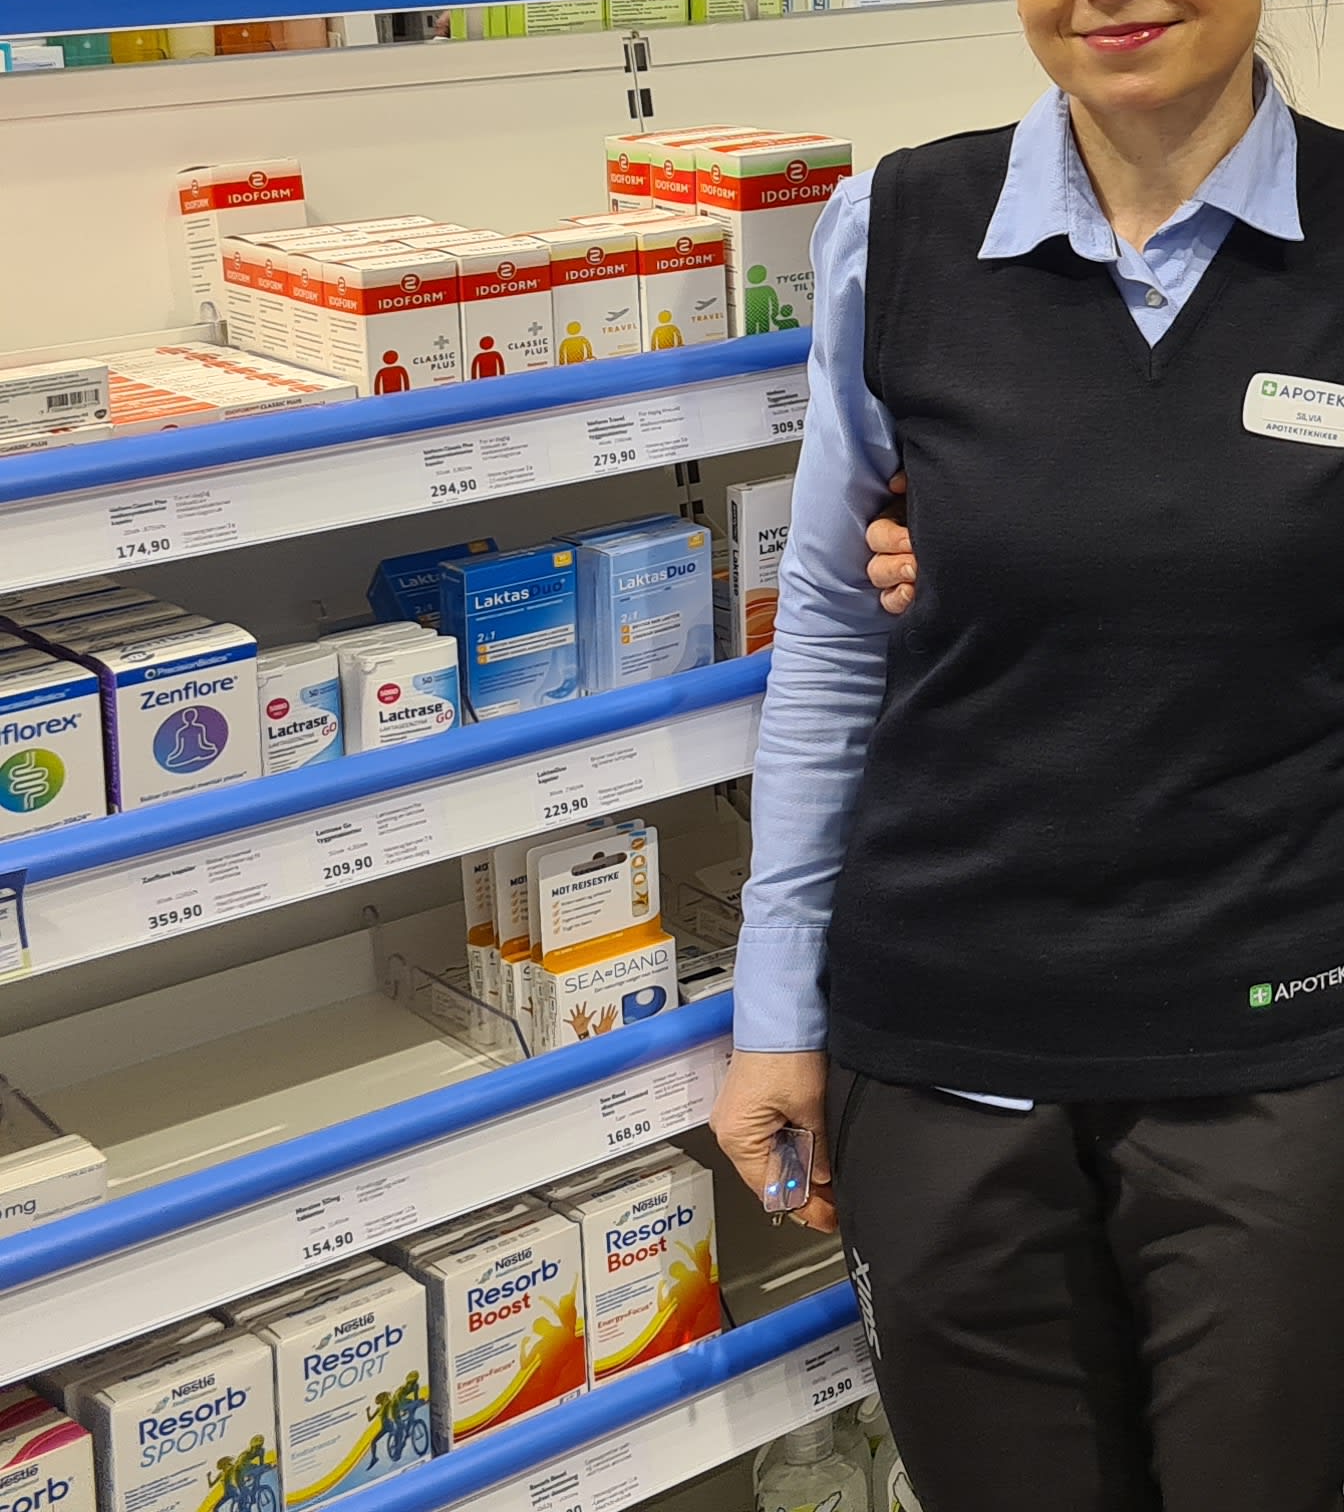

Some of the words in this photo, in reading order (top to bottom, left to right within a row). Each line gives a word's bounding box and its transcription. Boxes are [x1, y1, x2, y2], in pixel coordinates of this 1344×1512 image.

[228, 189, 292, 204] IDOFORM
[761, 184, 835, 204] IDOFORM
[565, 264, 625, 281] IDOFORM
[656, 254, 713, 271] IDOFORM
[475, 280, 538, 297] IDOFORM
[378, 292, 444, 310] IDOFORM
[602, 323, 638, 335] TRAVEL
[691, 312, 724, 323] TRAVEL
[507, 338, 548, 351] CLASSIC
[524, 346, 549, 356] PLUS
[412, 351, 456, 365] CLASSIC
[430, 360, 456, 371] PLUS
[771, 419, 805, 435] 309,9
[593, 449, 636, 467] 279,90
[430, 479, 477, 498] 294,90
[116, 539, 170, 559] 174,90
[618, 561, 697, 591] LaktasDuo
[474, 580, 563, 610] LaktasDuo
[140, 676, 235, 710] Zenflore
[379, 703, 443, 724] Lactrase
[435, 709, 453, 724] GO
[0, 714, 78, 746] florex
[268, 715, 329, 739] Lactrase
[321, 721, 337, 737] GO
[544, 797, 588, 819] 229,90
[323, 855, 373, 879] 209,90
[551, 884, 570, 897] MOT
[571, 871, 619, 892] REISESYKE
[148, 904, 203, 929] 359,90
[607, 1121, 651, 1145] 168,90
[632, 1191, 668, 1215] Nestlé
[605, 1205, 693, 1253] Resorb
[303, 1232, 353, 1259] 154,90
[607, 1237, 668, 1273] Boost
[495, 1247, 532, 1270] Nestlé
[467, 1260, 559, 1313] Resorb
[334, 1312, 375, 1336] Nestlé
[469, 1293, 531, 1333] Boost
[303, 1325, 403, 1380] Resorb
[171, 1373, 215, 1401] Nestlé
[304, 1351, 389, 1403] SPORT
[812, 1378, 853, 1406] 229,90
[139, 1387, 247, 1445] Resorb
[140, 1415, 232, 1468] SPORT
[0, 1464, 39, 1488] estlé
[0, 1478, 69, 1512] orb
